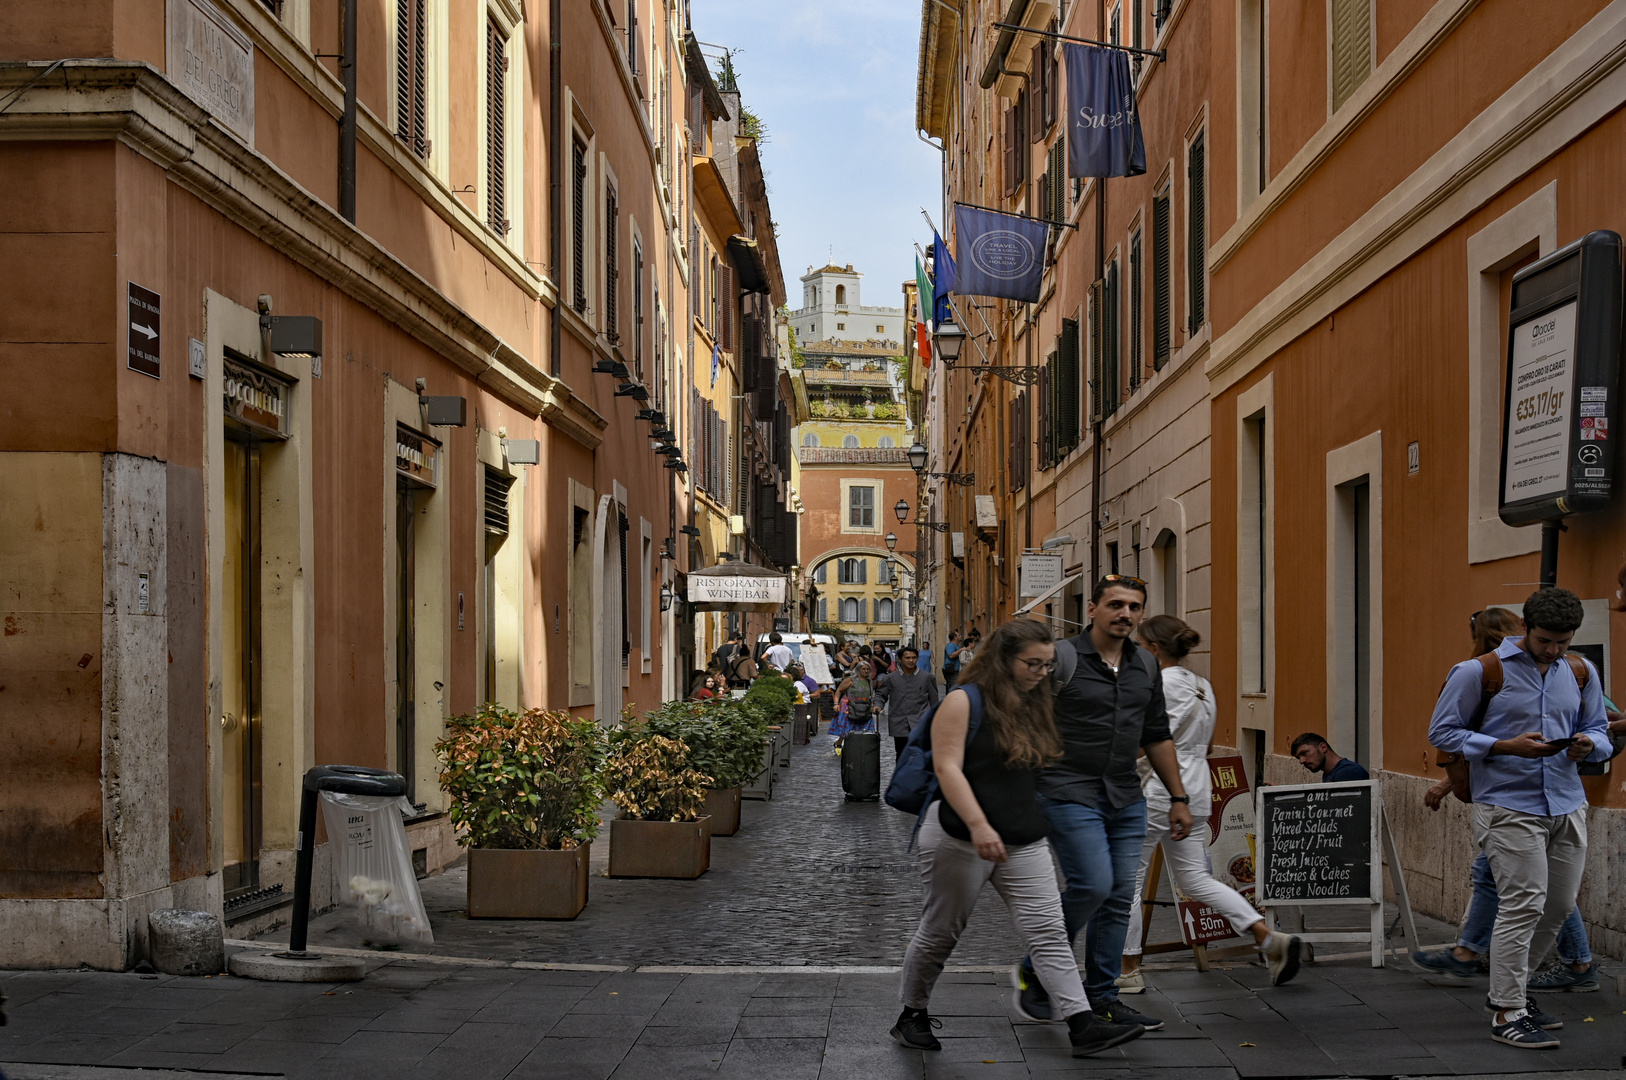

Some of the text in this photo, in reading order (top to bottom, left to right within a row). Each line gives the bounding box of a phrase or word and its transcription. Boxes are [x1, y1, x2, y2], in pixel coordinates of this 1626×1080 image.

[203, 21, 222, 59] VIA
[186, 49, 204, 85] DEI
[208, 69, 239, 112] GRECI
[1518, 369, 1534, 384] COMPRO
[1534, 366, 1544, 378] ORO
[1549, 358, 1566, 372] CARATI
[1516, 386, 1564, 421] €35,17/gr
[1410, 446, 1418, 470] 22
[695, 578, 780, 588] RISTORANTE
[706, 589, 770, 599] WINE BAR
[1212, 793, 1222, 802] EA
[1306, 790, 1329, 802] ami
[1272, 806, 1306, 822] Panini
[1272, 818, 1338, 836] Mixed Salads
[1272, 834, 1344, 854] Yogurt / Fruit
[1270, 852, 1330, 869] Fresh Juices
[1269, 866, 1350, 883] Pastries & Cakes
[1265, 881, 1350, 900] Veggie Noodles
[1200, 917, 1224, 931] 50m
